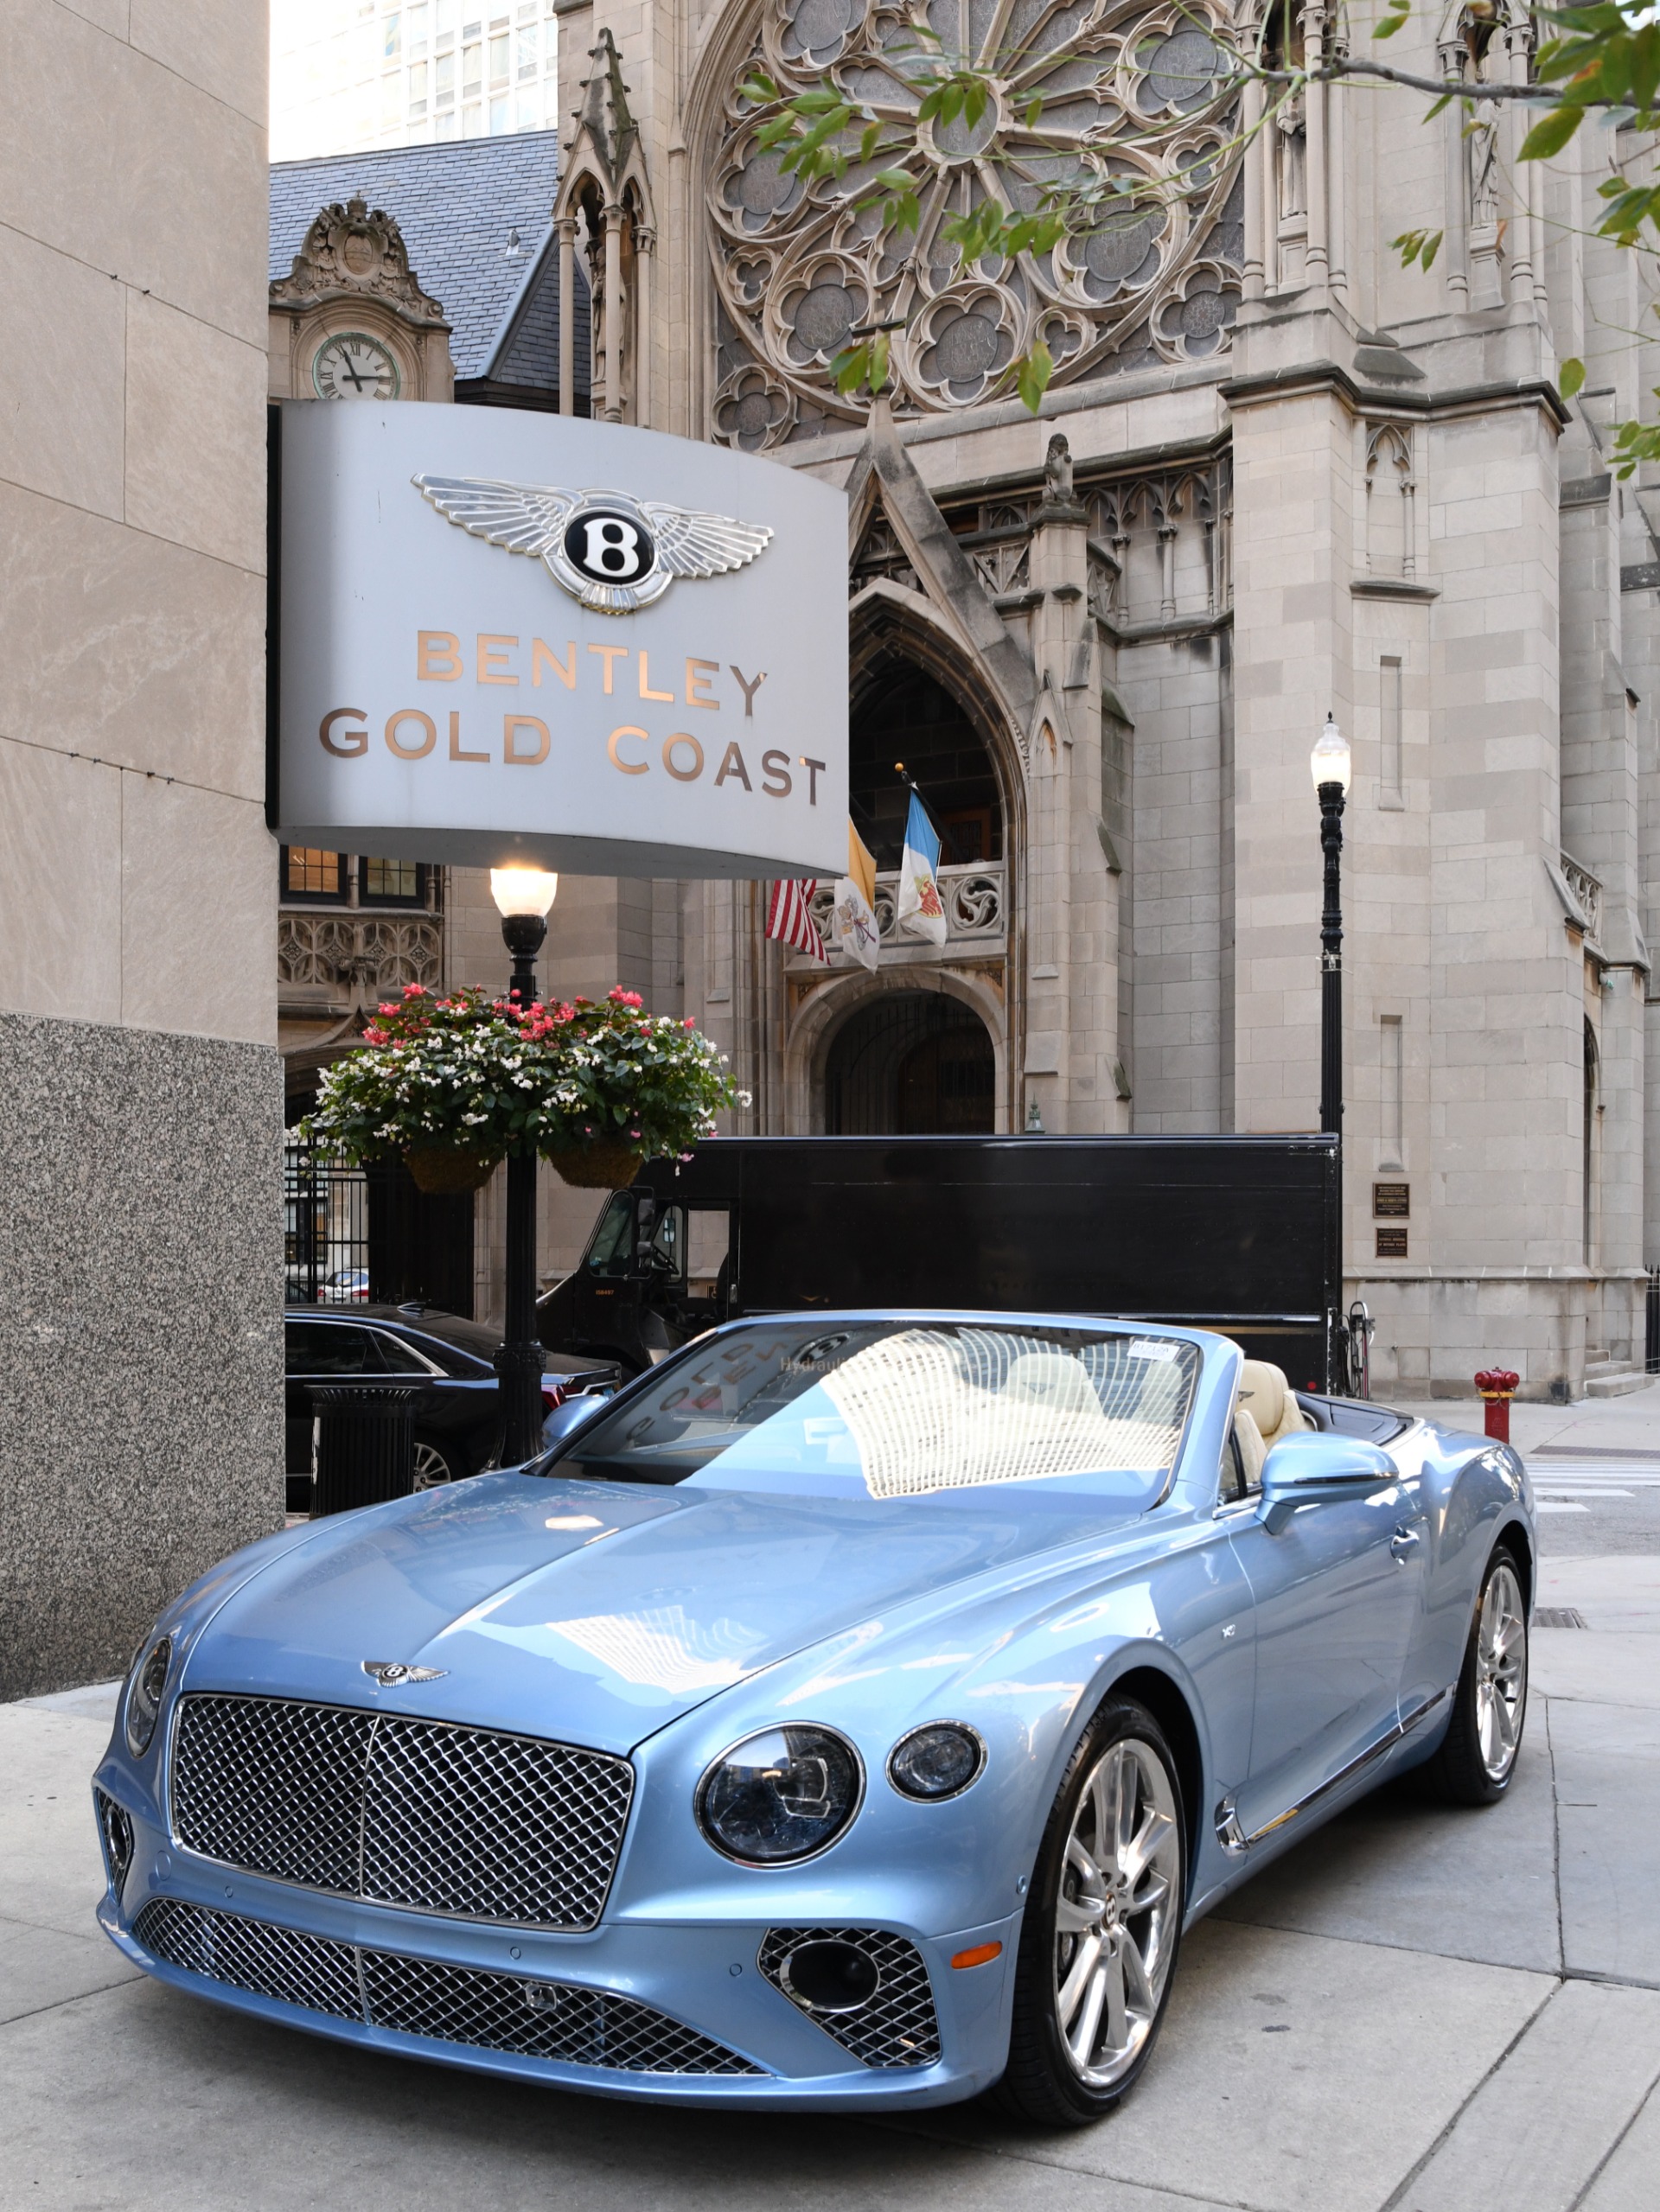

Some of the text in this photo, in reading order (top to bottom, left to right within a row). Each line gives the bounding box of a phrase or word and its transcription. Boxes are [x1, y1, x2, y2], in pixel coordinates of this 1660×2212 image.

[584, 518, 640, 577] B
[417, 630, 768, 717] BENTLEY
[318, 708, 827, 806] GOLD COAST
[386, 1666, 404, 1677] B
